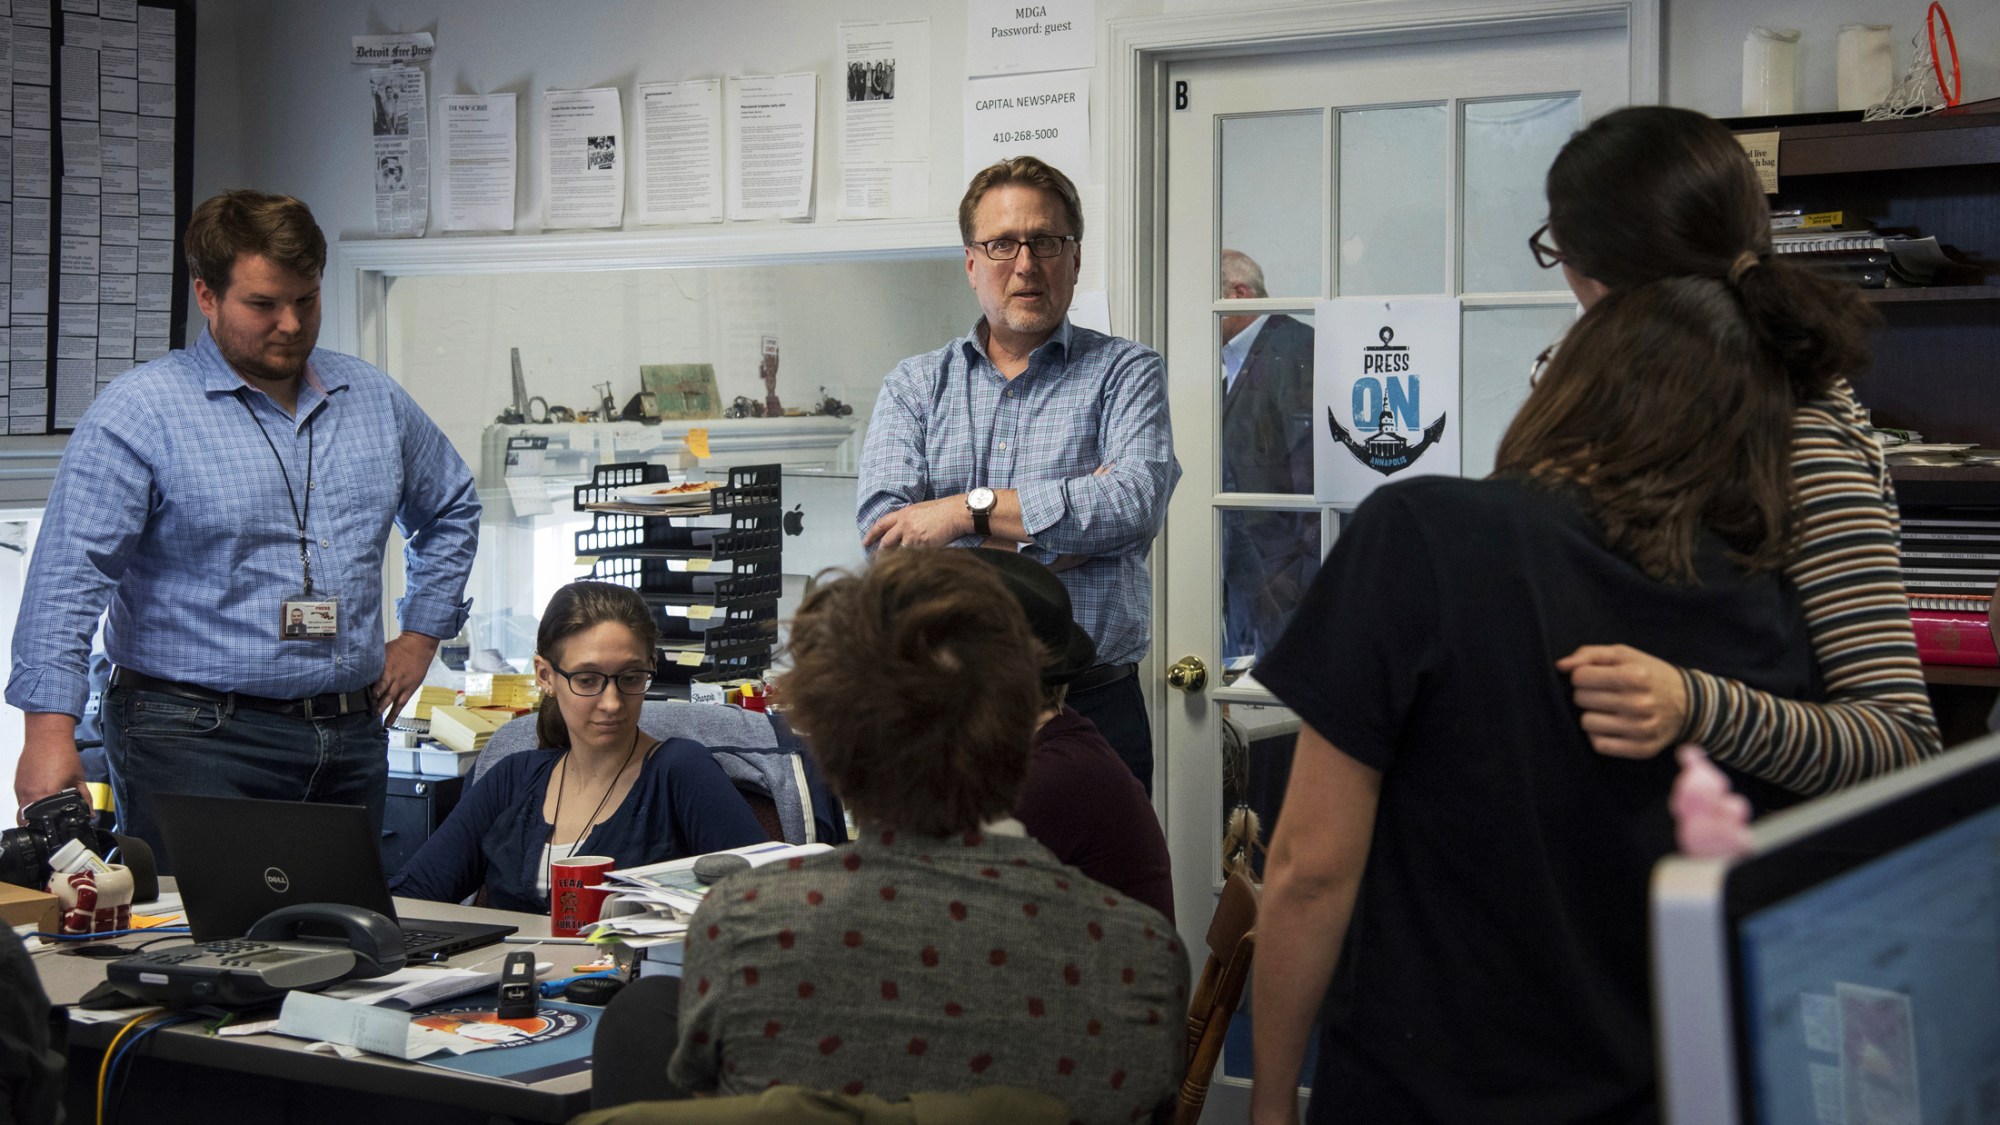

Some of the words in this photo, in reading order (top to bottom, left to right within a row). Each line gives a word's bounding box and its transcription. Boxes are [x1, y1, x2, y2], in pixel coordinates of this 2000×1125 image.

[1015, 5, 1047, 19] MDGA
[991, 22, 1042, 38] Password:
[1044, 21, 1072, 36] guest
[356, 45, 390, 58] Detroit
[391, 45, 410, 58] Free
[411, 44, 433, 58] Press
[975, 98, 1014, 111] CAPITAL
[1016, 92, 1076, 107] NEWSPAPER
[1175, 80, 1188, 110] B
[993, 127, 1058, 143] 410-268-5000
[1754, 149, 1768, 158] live
[1762, 158, 1776, 168] bag
[1364, 353, 1410, 374] PRESS
[1352, 374, 1420, 432] ON
[1370, 455, 1408, 467] ANNAPOLIS
[692, 693, 715, 703] Sharpie
[267, 875, 287, 884] DELL
[558, 879, 585, 889] FEAR
